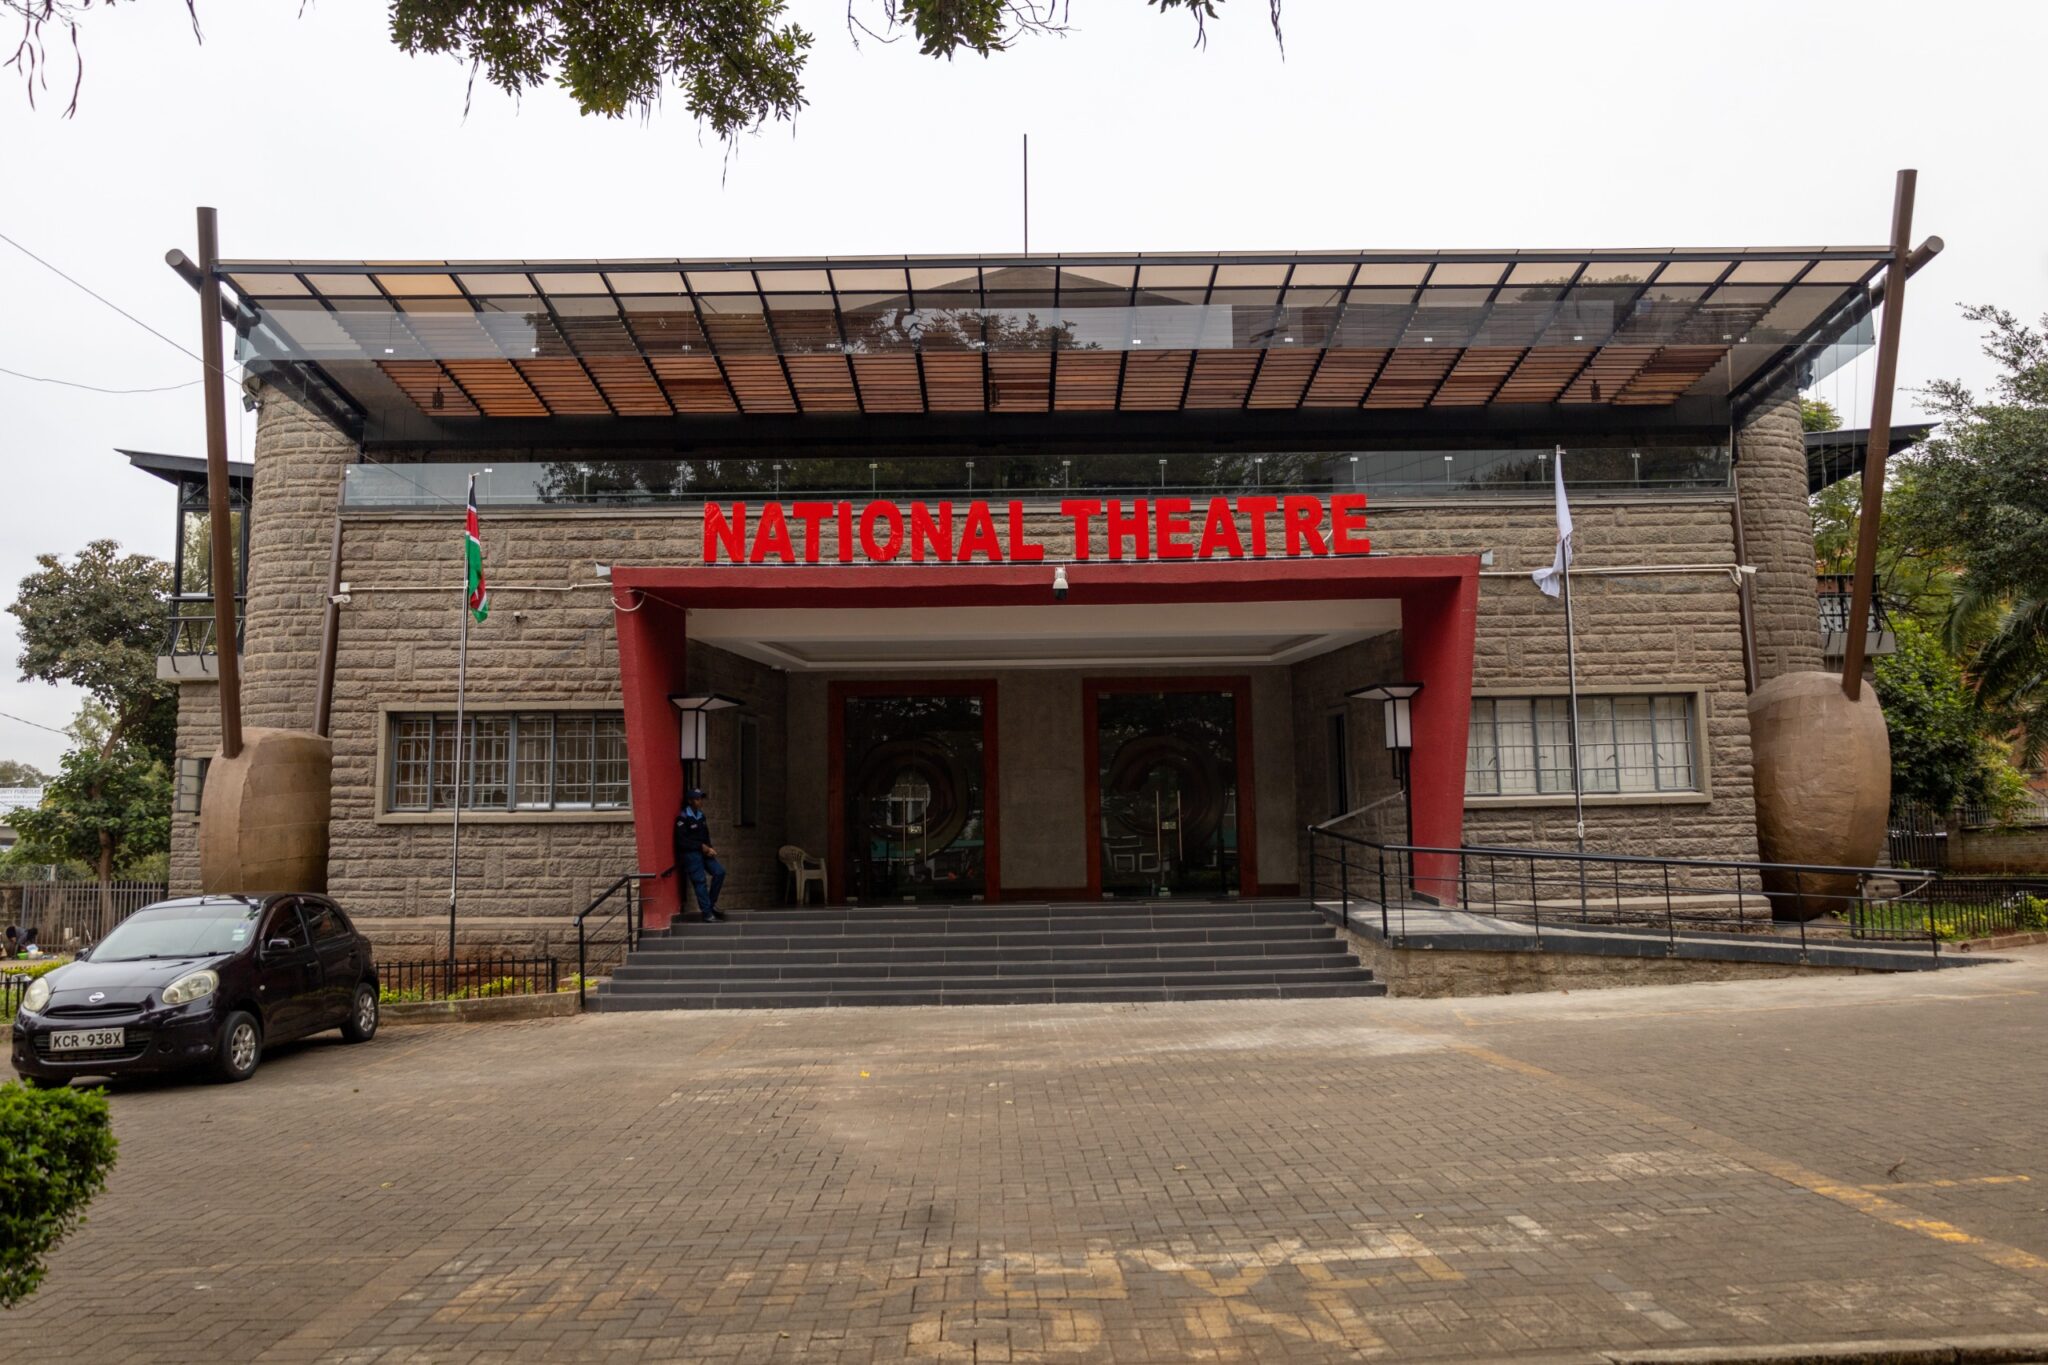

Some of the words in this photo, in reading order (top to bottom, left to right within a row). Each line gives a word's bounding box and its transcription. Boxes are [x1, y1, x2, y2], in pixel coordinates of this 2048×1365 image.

[704, 500, 1044, 562] NATIONAL
[1062, 494, 1370, 560] THEATRE
[53, 1034, 80, 1049] KCR
[87, 1031, 121, 1046] 938X
